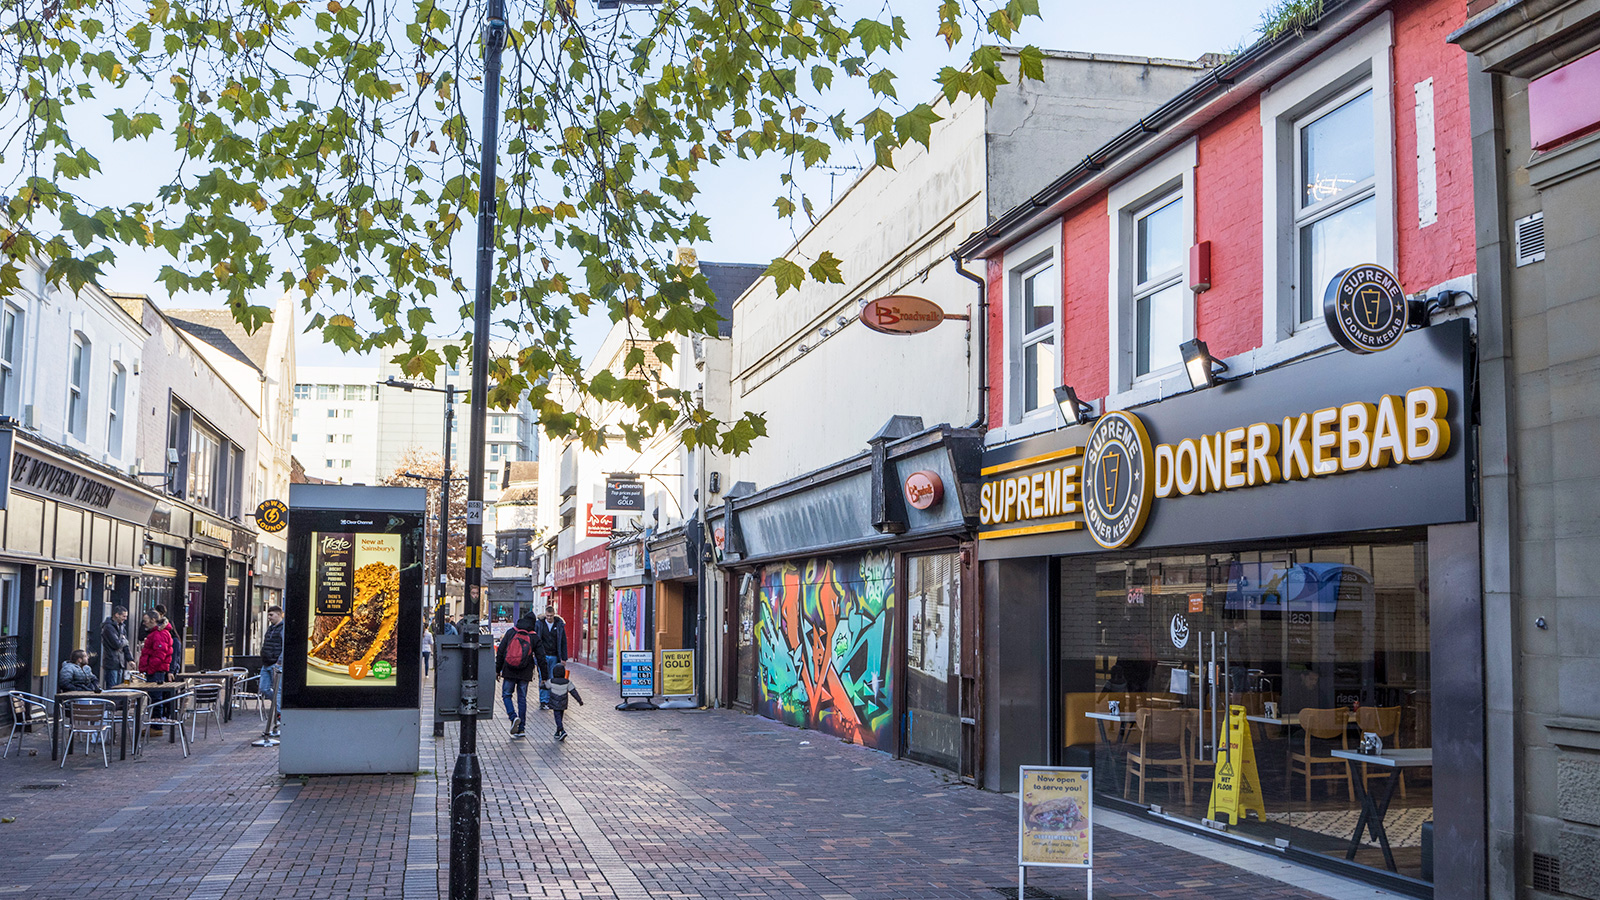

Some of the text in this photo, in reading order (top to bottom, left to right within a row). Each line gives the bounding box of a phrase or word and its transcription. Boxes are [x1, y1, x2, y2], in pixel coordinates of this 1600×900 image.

[1343, 270, 1399, 297] SUPREME
[1345, 316, 1402, 344] DONER KEBAB
[979, 386, 1447, 525] SUPREME DONER KEBAB
[1088, 420, 1139, 464] SUPREME
[27, 458, 80, 498] WYVERN
[75, 476, 116, 509] TAVERN
[257, 518, 286, 531] LOUNGE
[469, 511, 479, 519] 24
[1087, 494, 1139, 539] DONER KEBAB
[1127, 593, 1144, 604] OPEN
[355, 667, 362, 676] 7
[664, 660, 691, 668] GOLD
